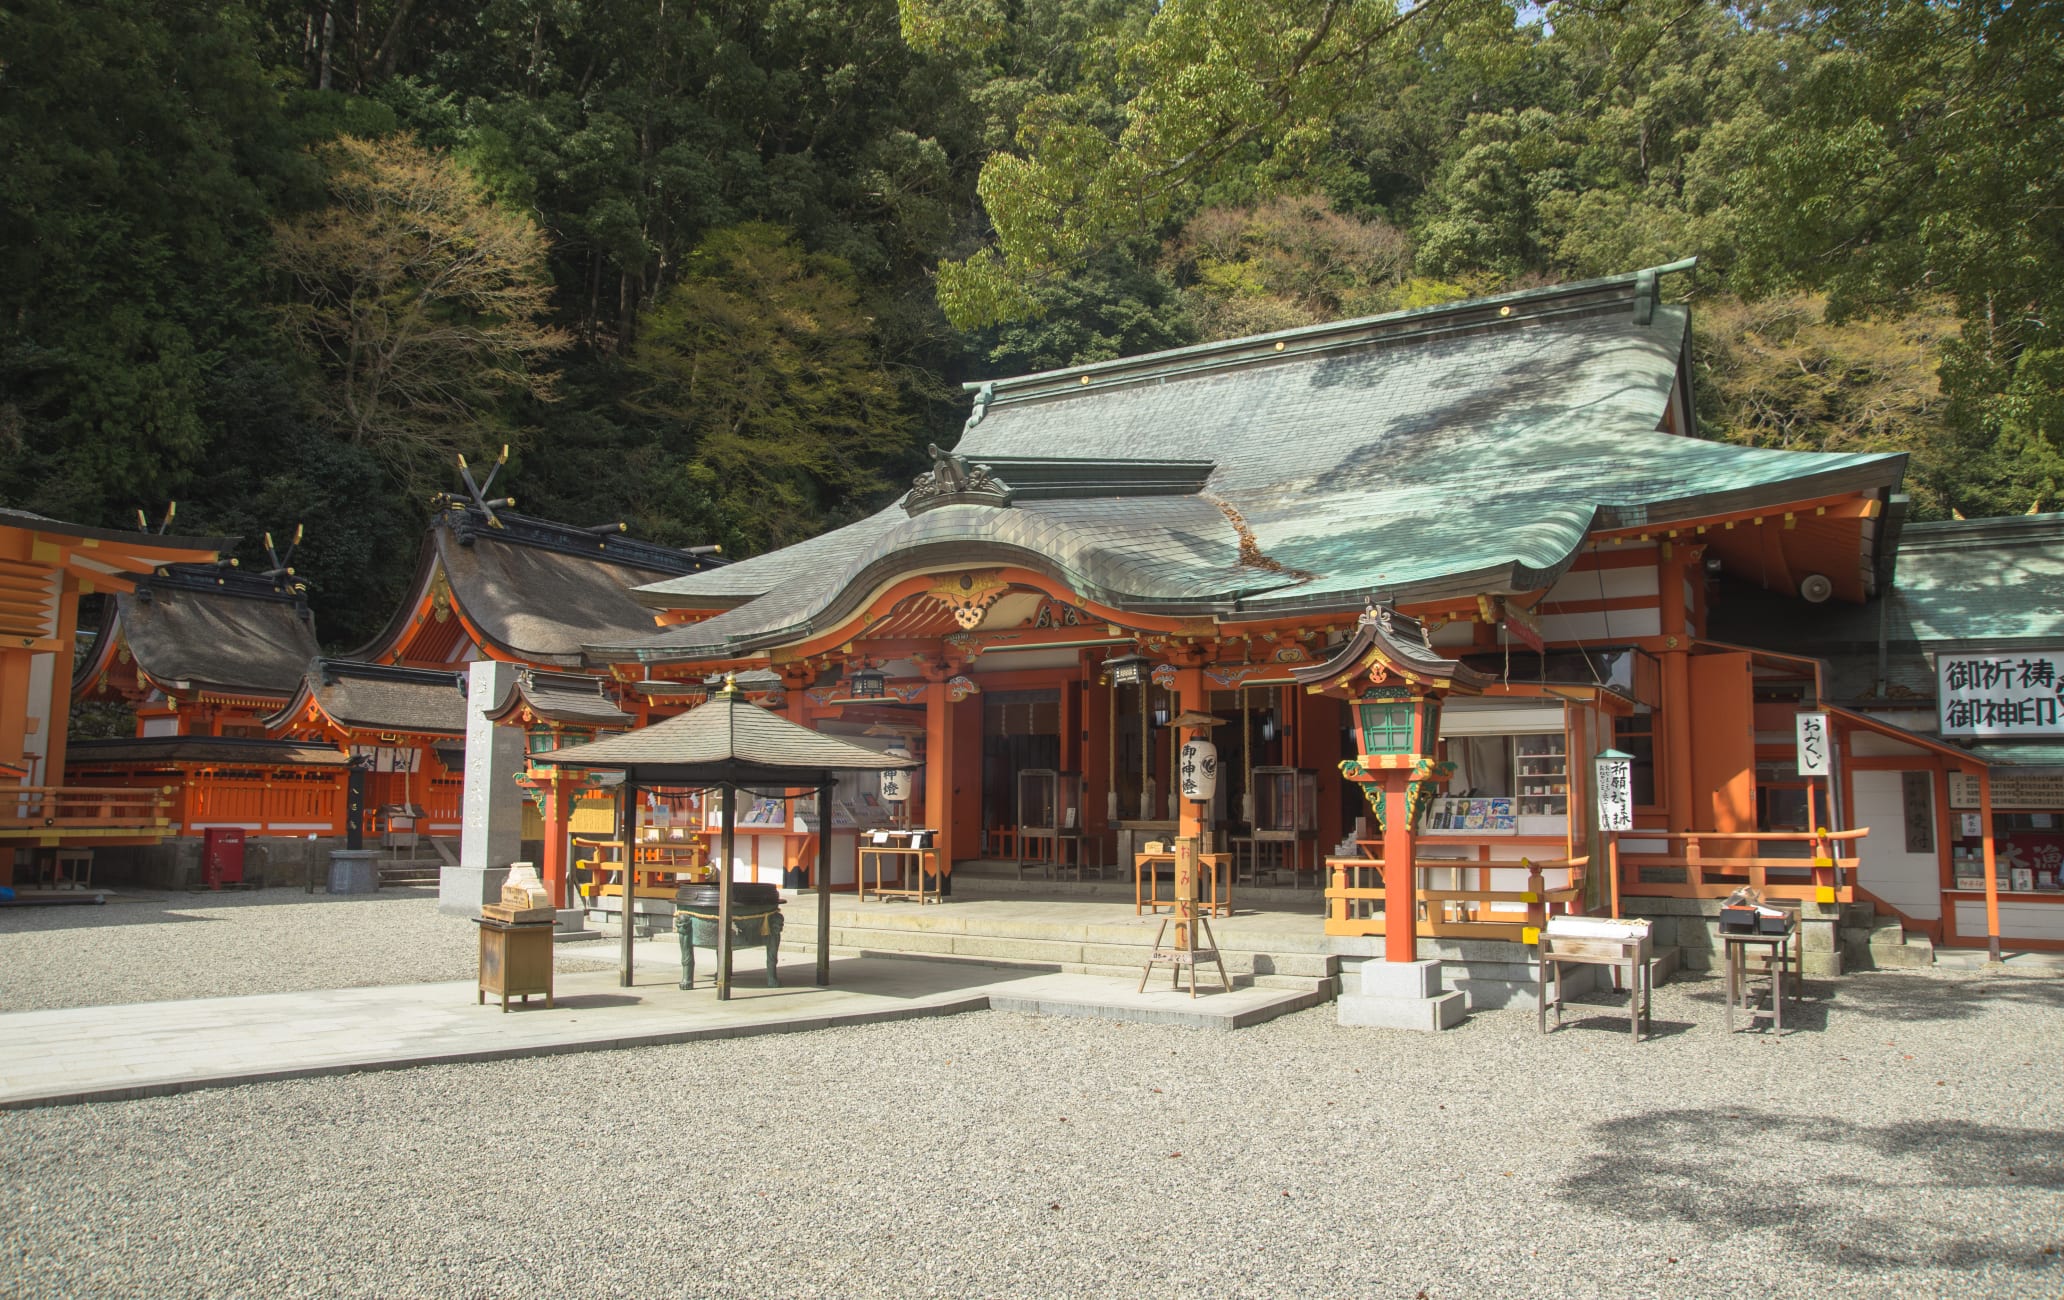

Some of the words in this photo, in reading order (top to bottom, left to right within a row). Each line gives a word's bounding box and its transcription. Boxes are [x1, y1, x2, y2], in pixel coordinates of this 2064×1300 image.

[1945, 658, 2056, 692] 御祈祷
[1945, 697, 2058, 728] 御神印
[1803, 717, 1823, 769] おみくじ
[1181, 743, 1198, 794] 御神燈
